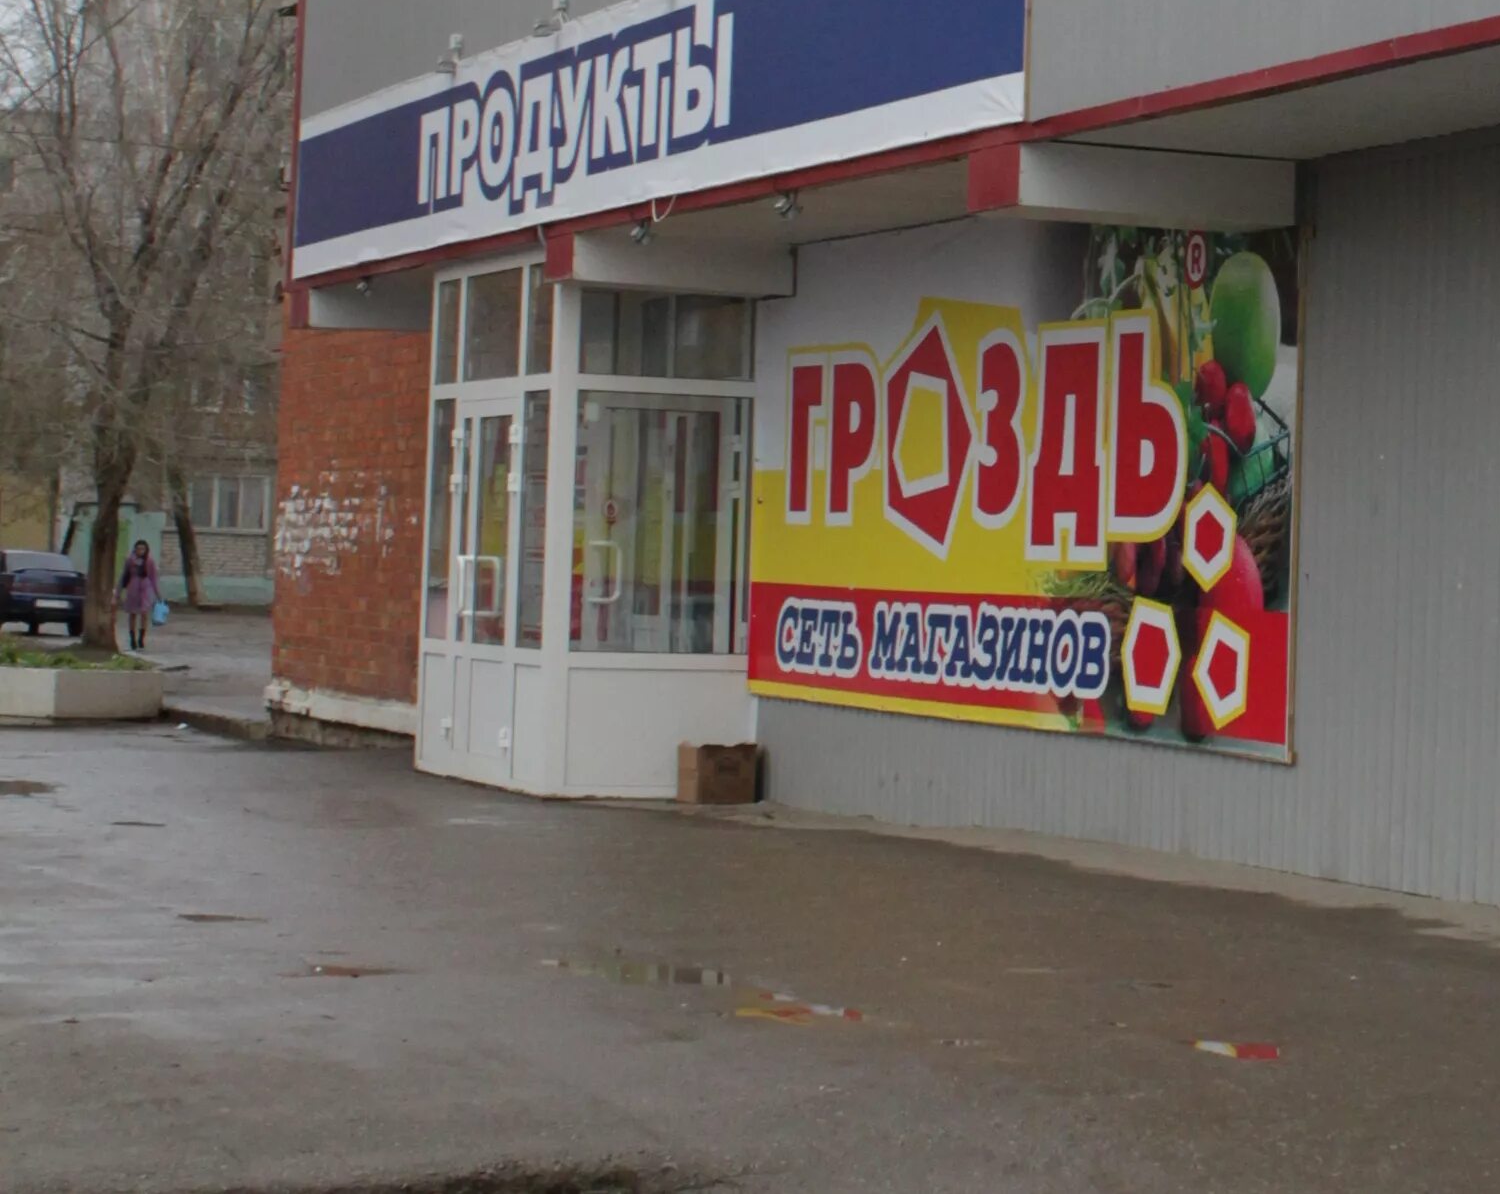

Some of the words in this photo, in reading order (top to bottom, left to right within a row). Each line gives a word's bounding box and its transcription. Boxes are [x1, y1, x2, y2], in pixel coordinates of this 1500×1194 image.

[415, 11, 734, 208] ПРОДУКТЫ
[786, 321, 1182, 551] ГРОЗДЬ
[776, 601, 859, 672] СЕТЬ
[871, 604, 1110, 694] МАГАЗИНОВ
